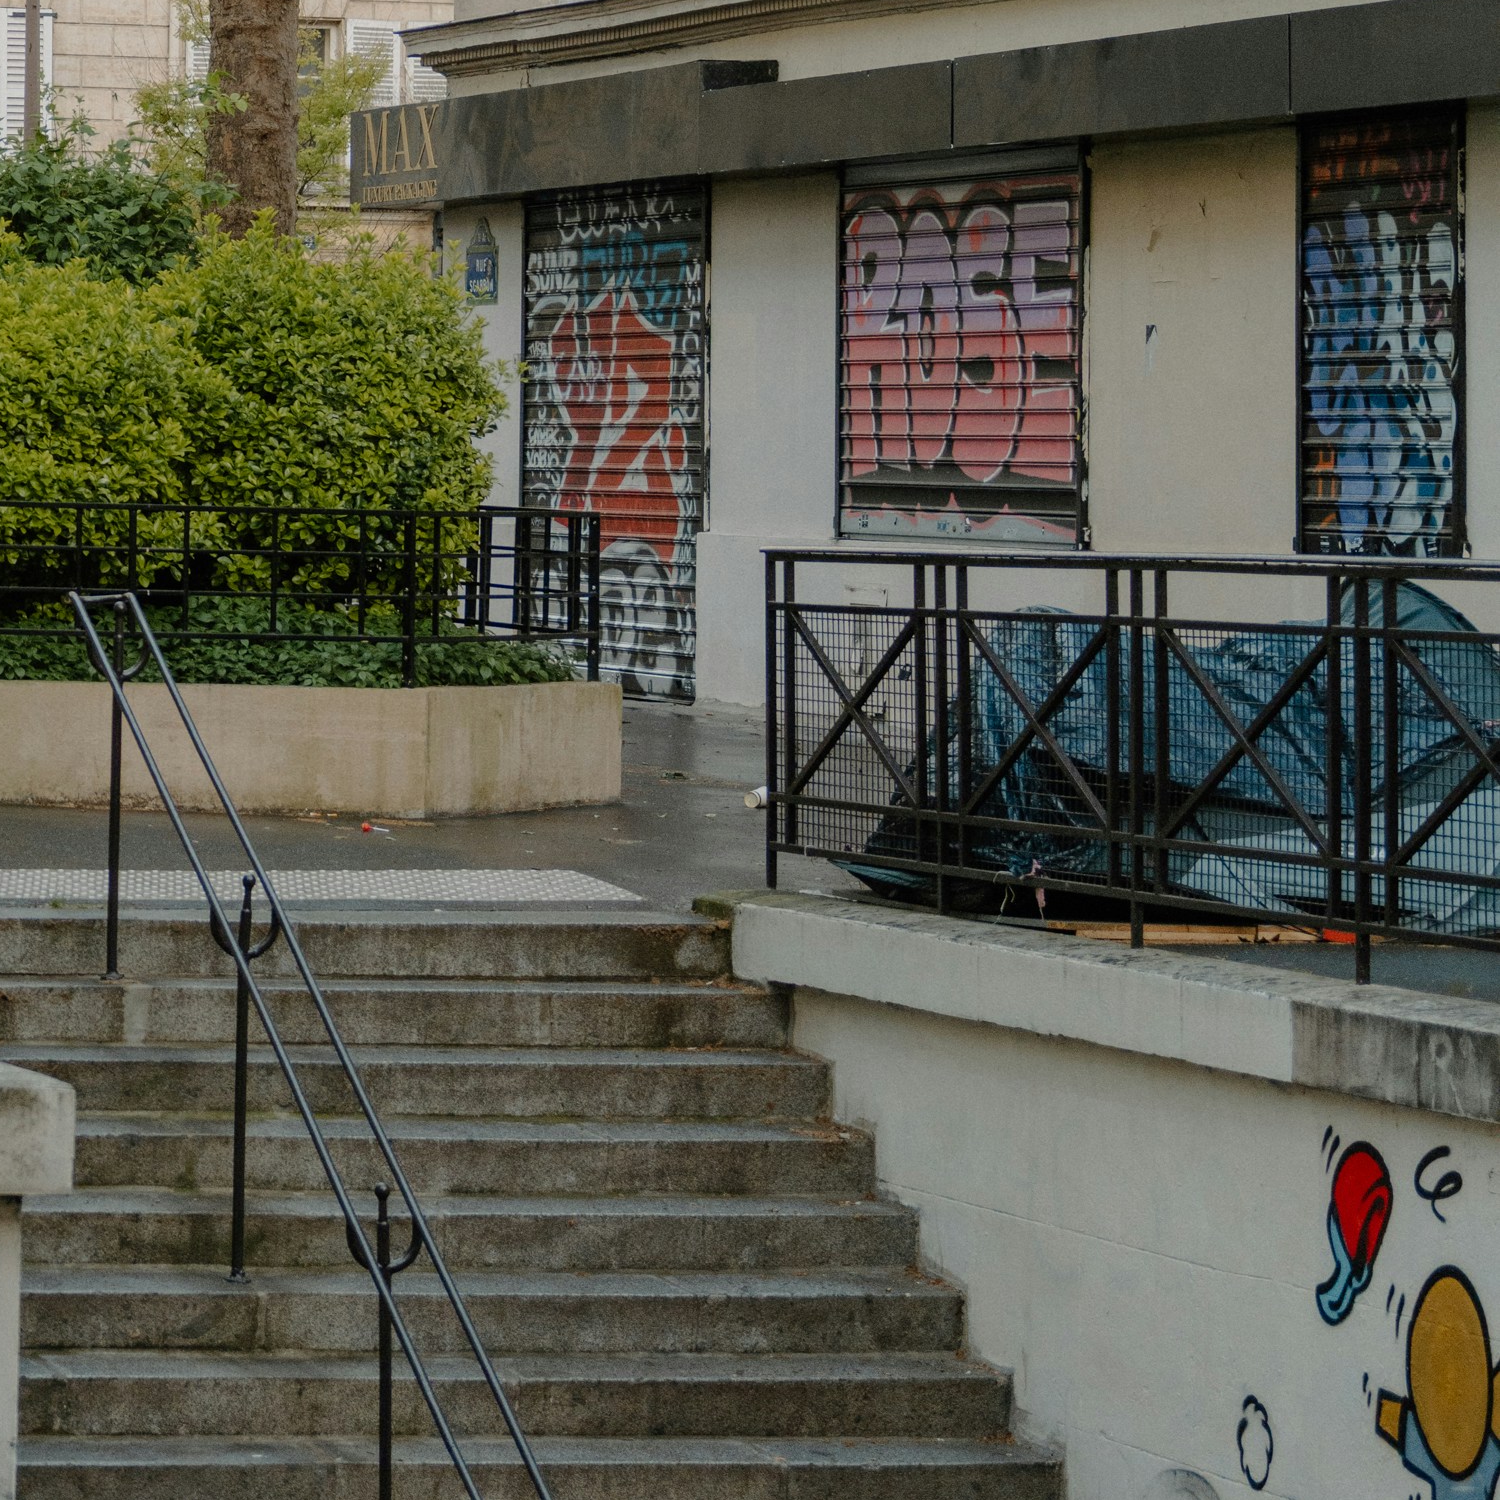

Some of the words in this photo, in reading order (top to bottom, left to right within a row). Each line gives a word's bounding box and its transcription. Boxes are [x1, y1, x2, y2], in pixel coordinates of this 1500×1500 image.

[362, 104, 440, 177] MAX
[362, 184, 394, 204] LUXURY
[395, 179, 438, 201] PACKAGING
